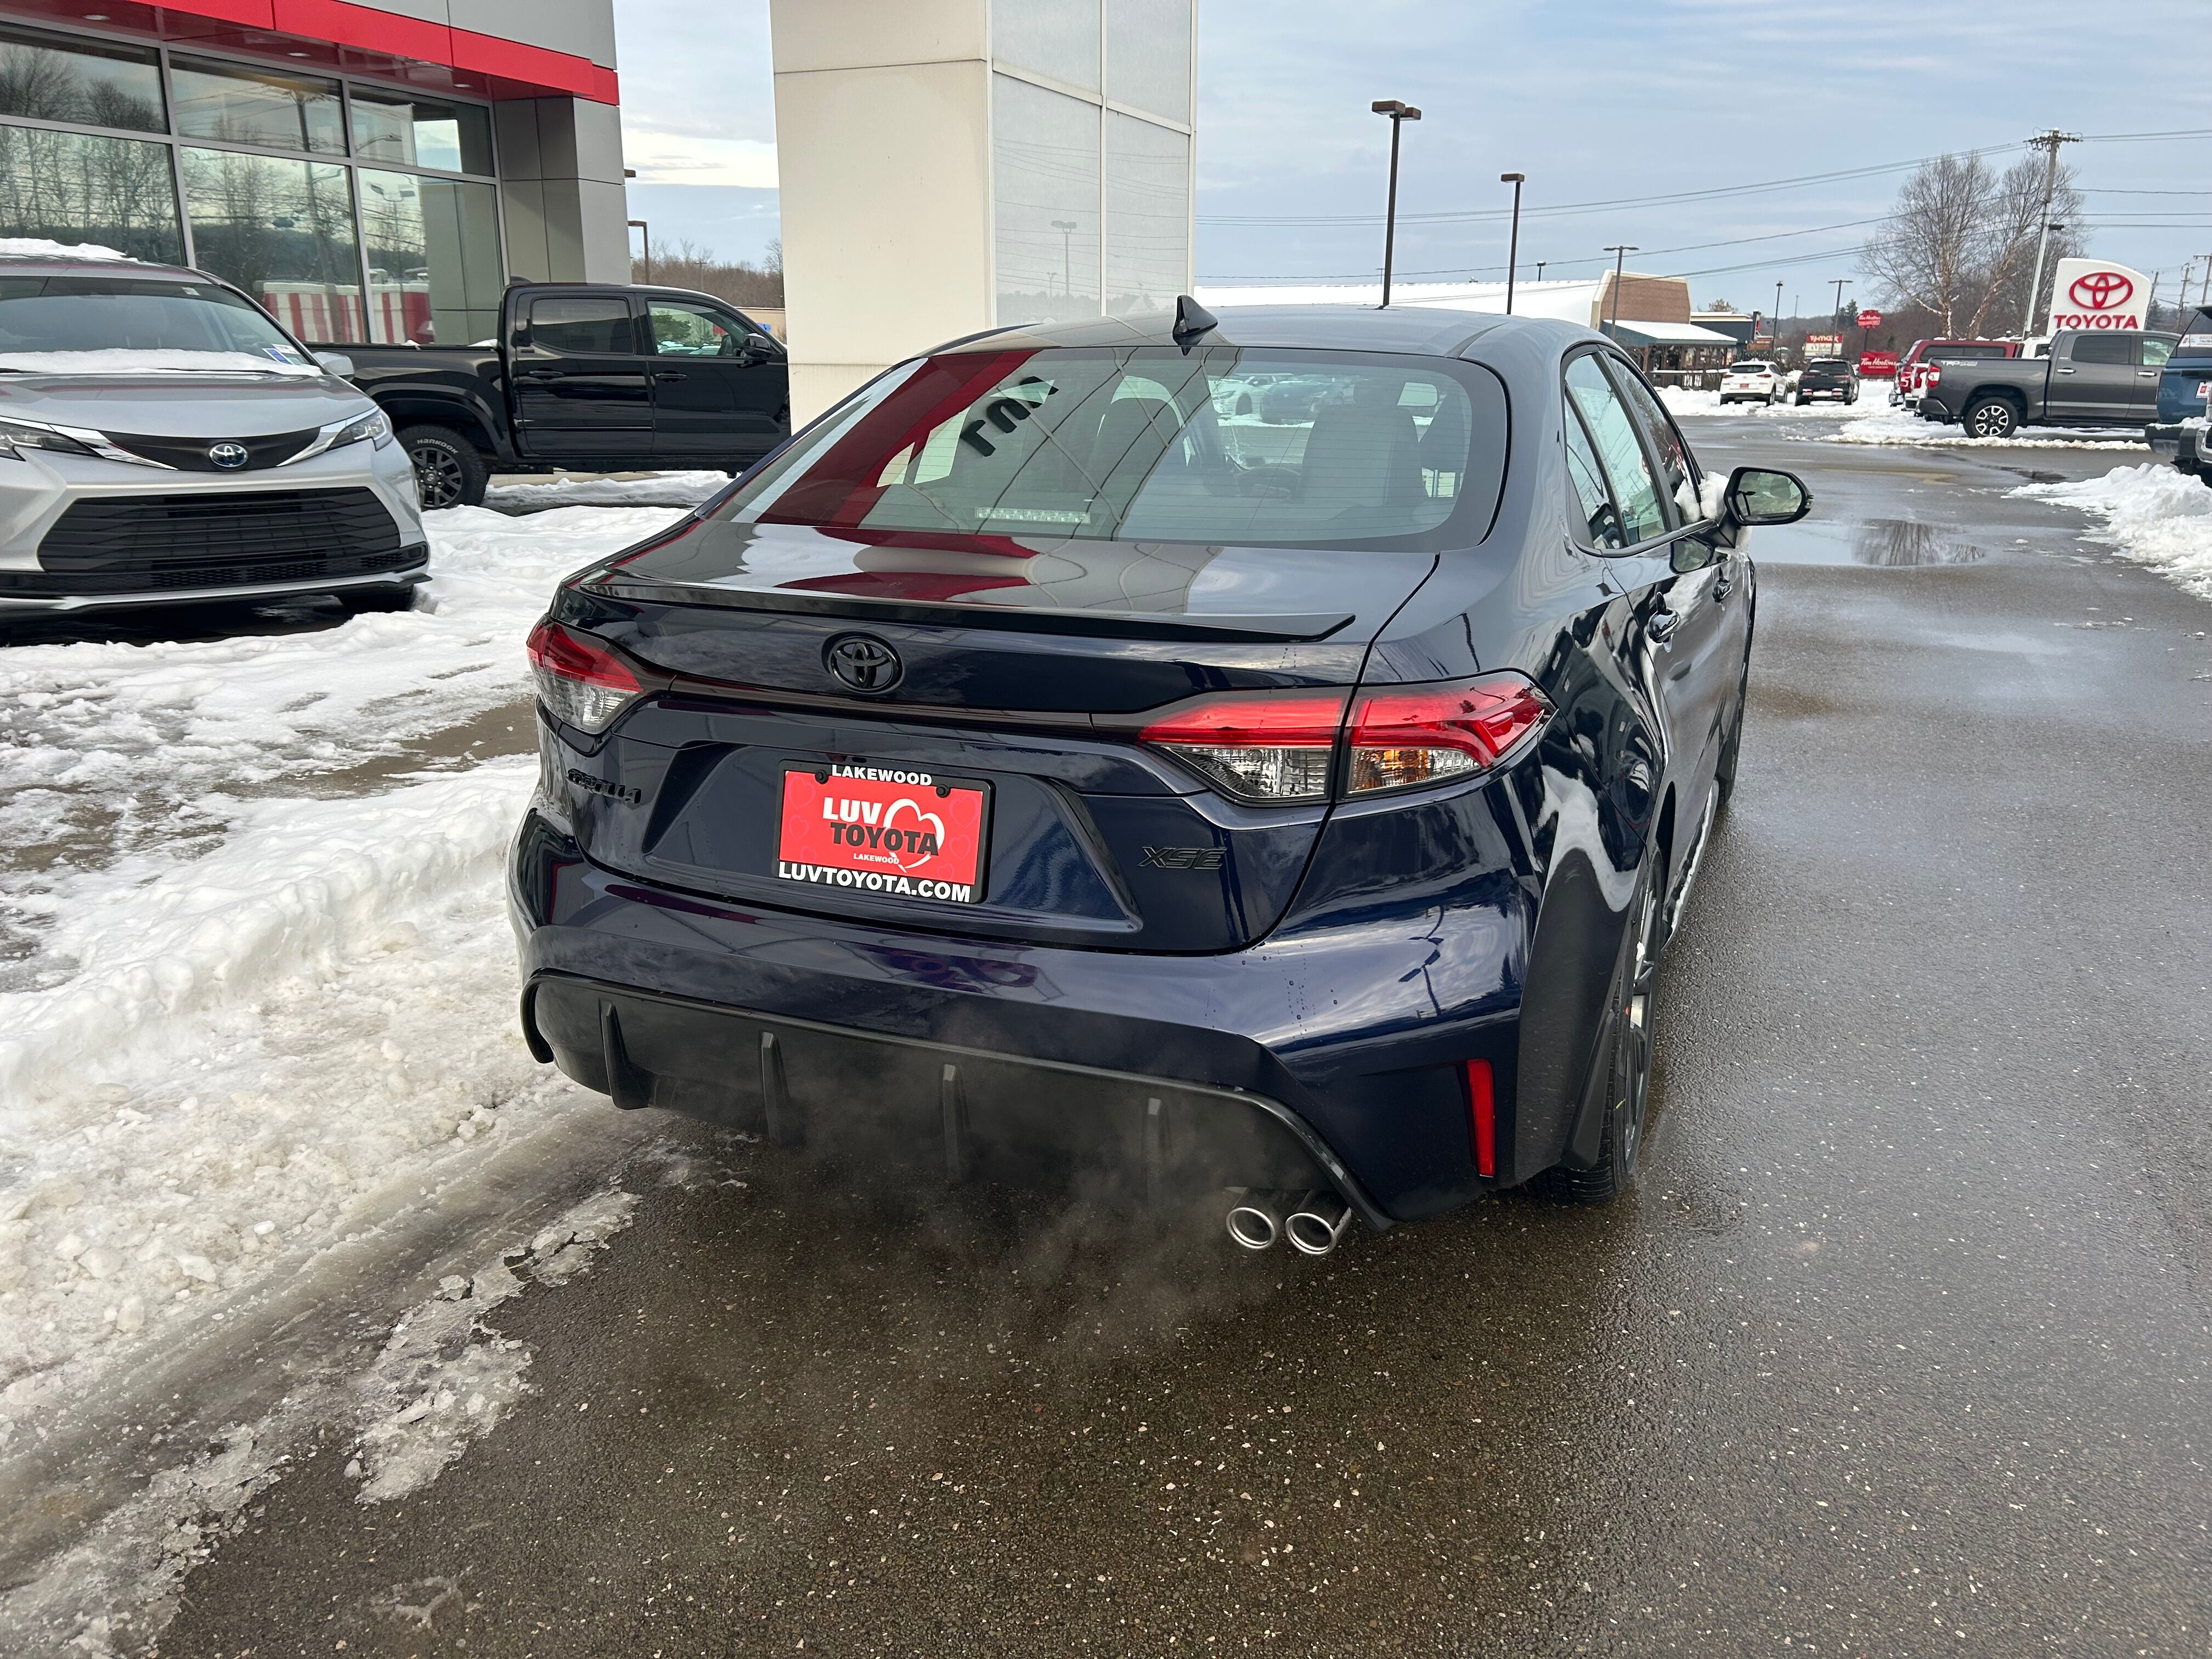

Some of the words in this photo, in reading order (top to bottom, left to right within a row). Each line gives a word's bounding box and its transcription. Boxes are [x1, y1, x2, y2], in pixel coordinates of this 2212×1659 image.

[2054, 314, 2138, 329] TOYOTA
[1872, 358, 1897, 366] Hortons
[567, 769, 642, 804] COROLLA
[831, 764, 933, 786] LAKEWOOD
[822, 797, 883, 825] LUV
[830, 822, 940, 856] TOYOTA
[853, 853, 900, 866] LAKEWOOD
[1137, 845, 1228, 870] XSE
[778, 861, 970, 903] LUVTOYOTA.COM
